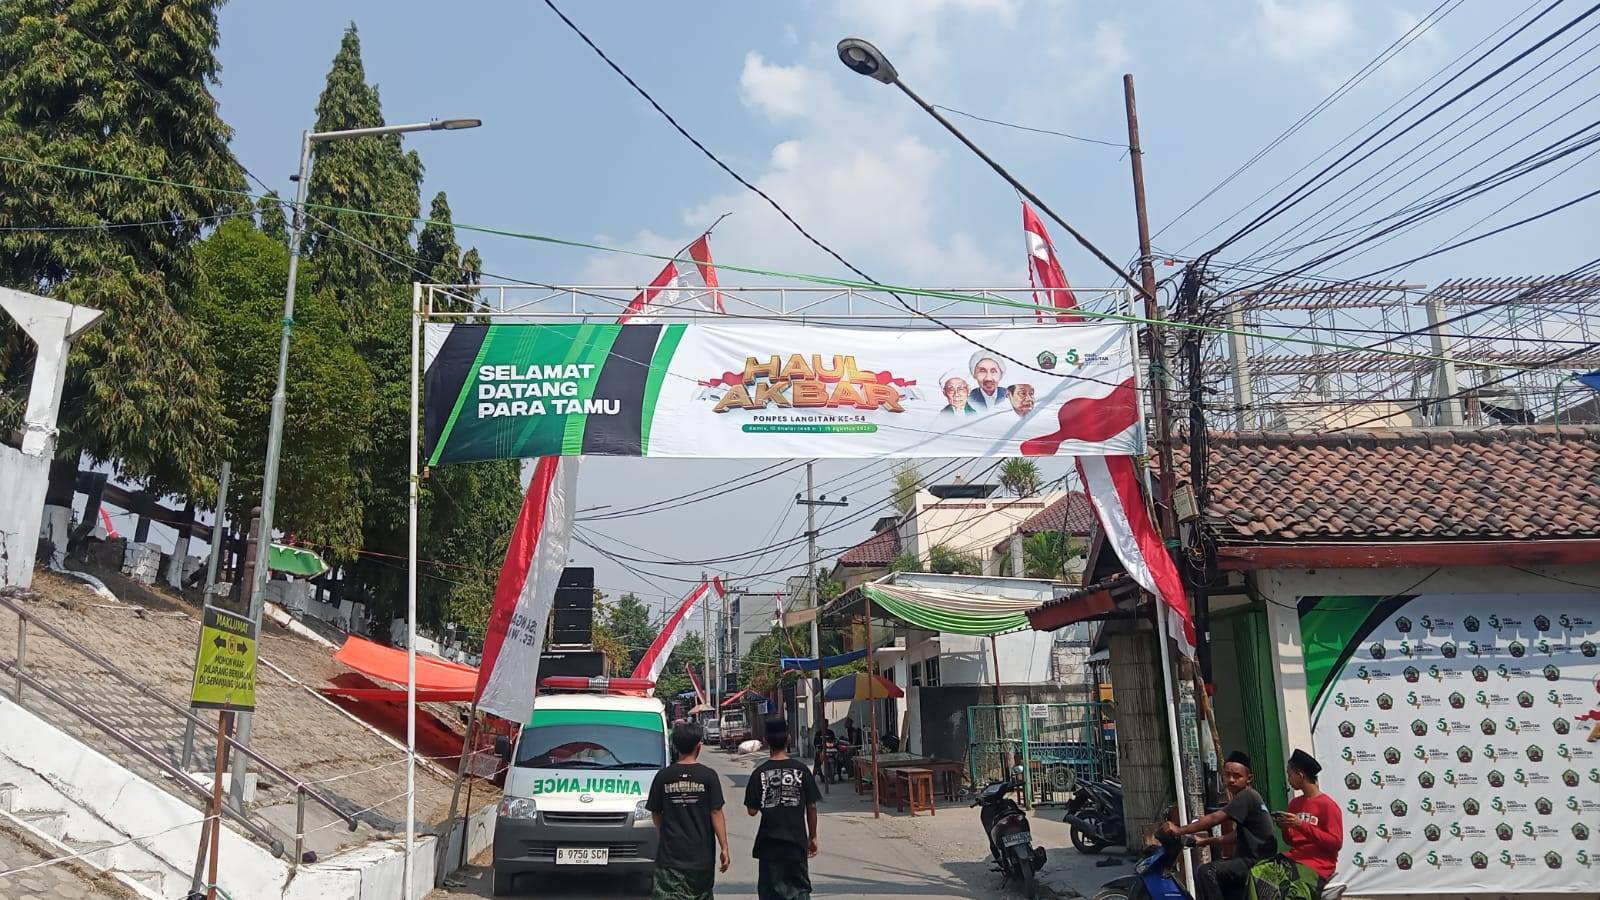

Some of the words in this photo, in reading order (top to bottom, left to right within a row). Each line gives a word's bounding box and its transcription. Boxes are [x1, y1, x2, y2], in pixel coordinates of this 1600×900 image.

[479, 364, 595, 381] SELAMAT
[744, 354, 878, 385] HAUL
[478, 381, 578, 400] DATANG
[712, 381, 906, 413] AKBAR
[478, 400, 547, 419] PARA
[551, 399, 620, 415] TAMU
[753, 415, 788, 423] PONPES
[216, 612, 248, 633] MAKLUMAT
[559, 850, 563, 859] B
[591, 850, 607, 859] SCM
